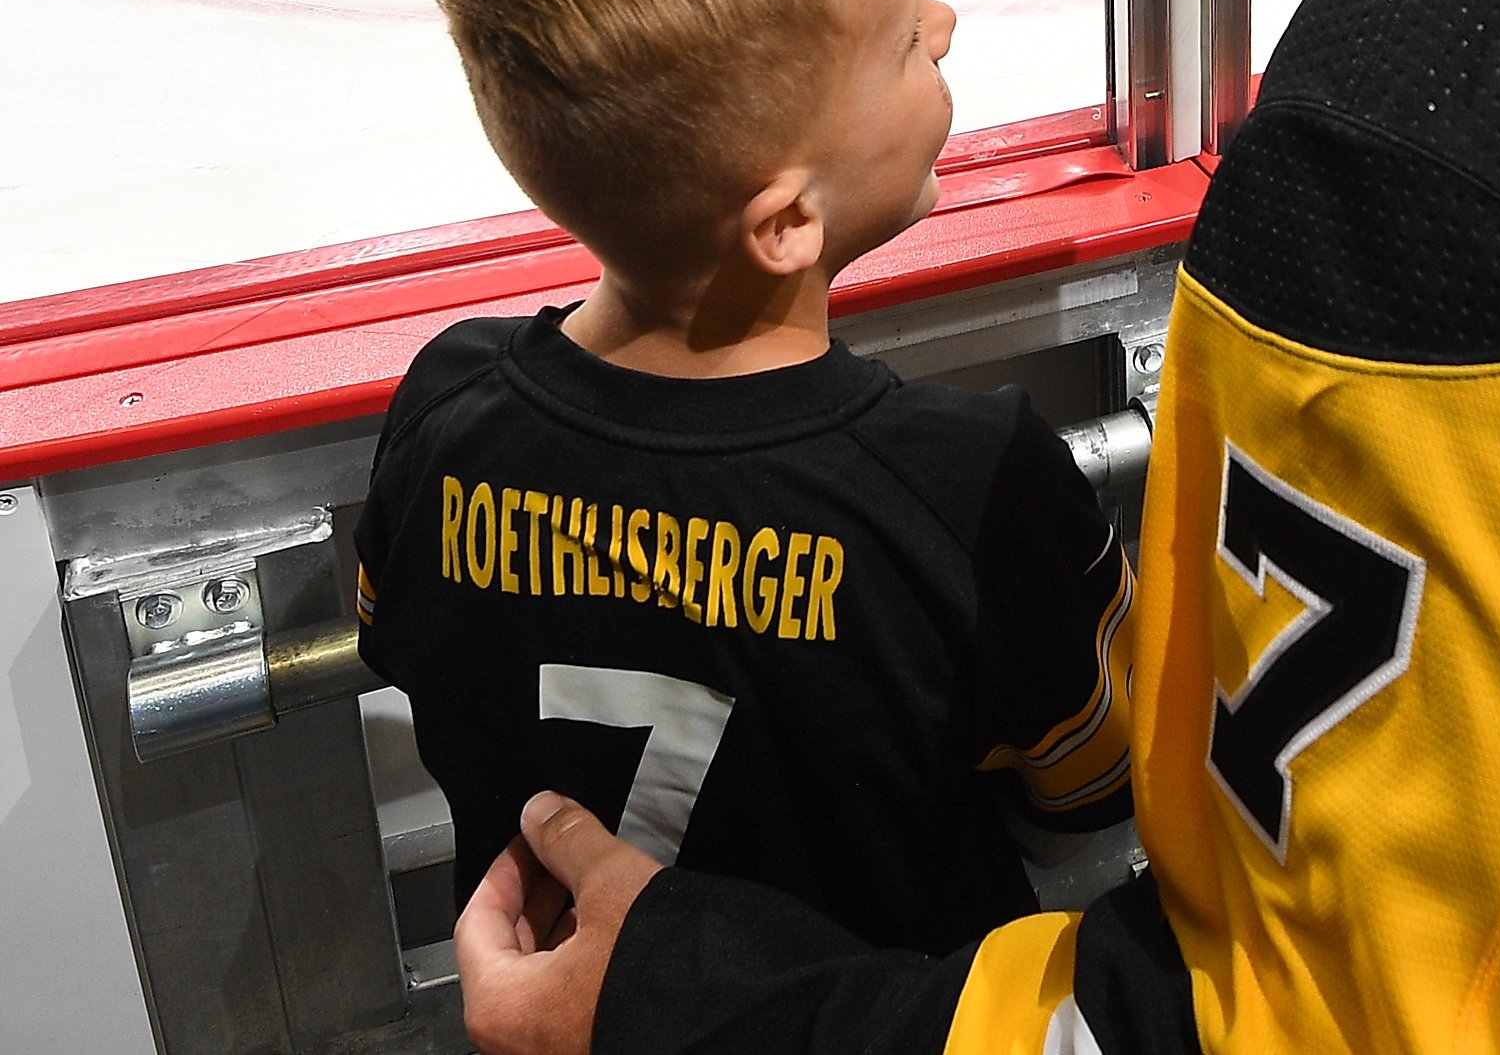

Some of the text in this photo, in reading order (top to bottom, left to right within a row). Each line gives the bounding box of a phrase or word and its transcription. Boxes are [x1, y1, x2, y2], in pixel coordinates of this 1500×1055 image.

[442, 475, 846, 641] ROETHLISBERGER
[1206, 436, 1427, 866] 7
[539, 663, 736, 867] 7
